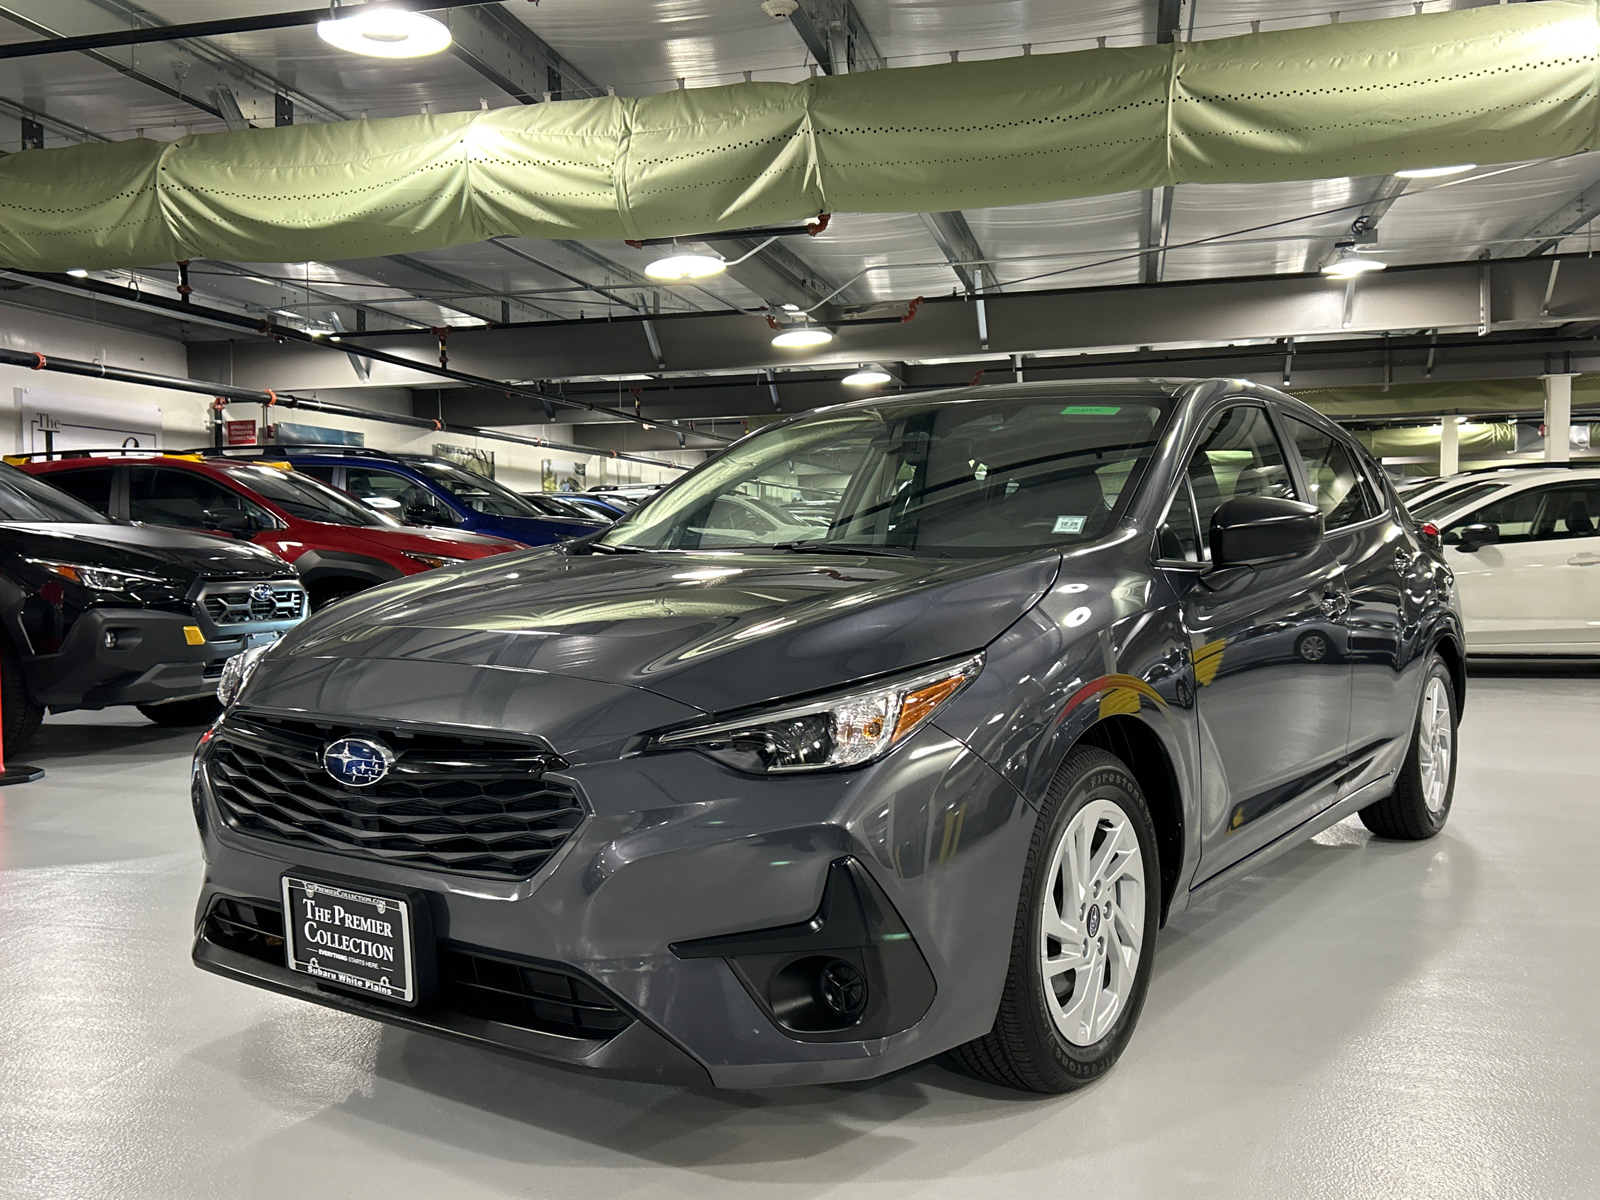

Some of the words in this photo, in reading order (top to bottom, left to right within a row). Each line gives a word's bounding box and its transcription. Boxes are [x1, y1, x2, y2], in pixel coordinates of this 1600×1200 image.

[36, 412, 60, 429] The
[1090, 773, 1144, 810] Firestone
[302, 898, 332, 924] THE
[333, 905, 393, 938] PREMIER
[304, 921, 394, 962] COLLECTION
[318, 949, 348, 962] EVERYTHING
[348, 956, 365, 966] STARTS
[307, 965, 337, 980] Subaru
[338, 973, 363, 987] White
[365, 981, 392, 995] Plains
